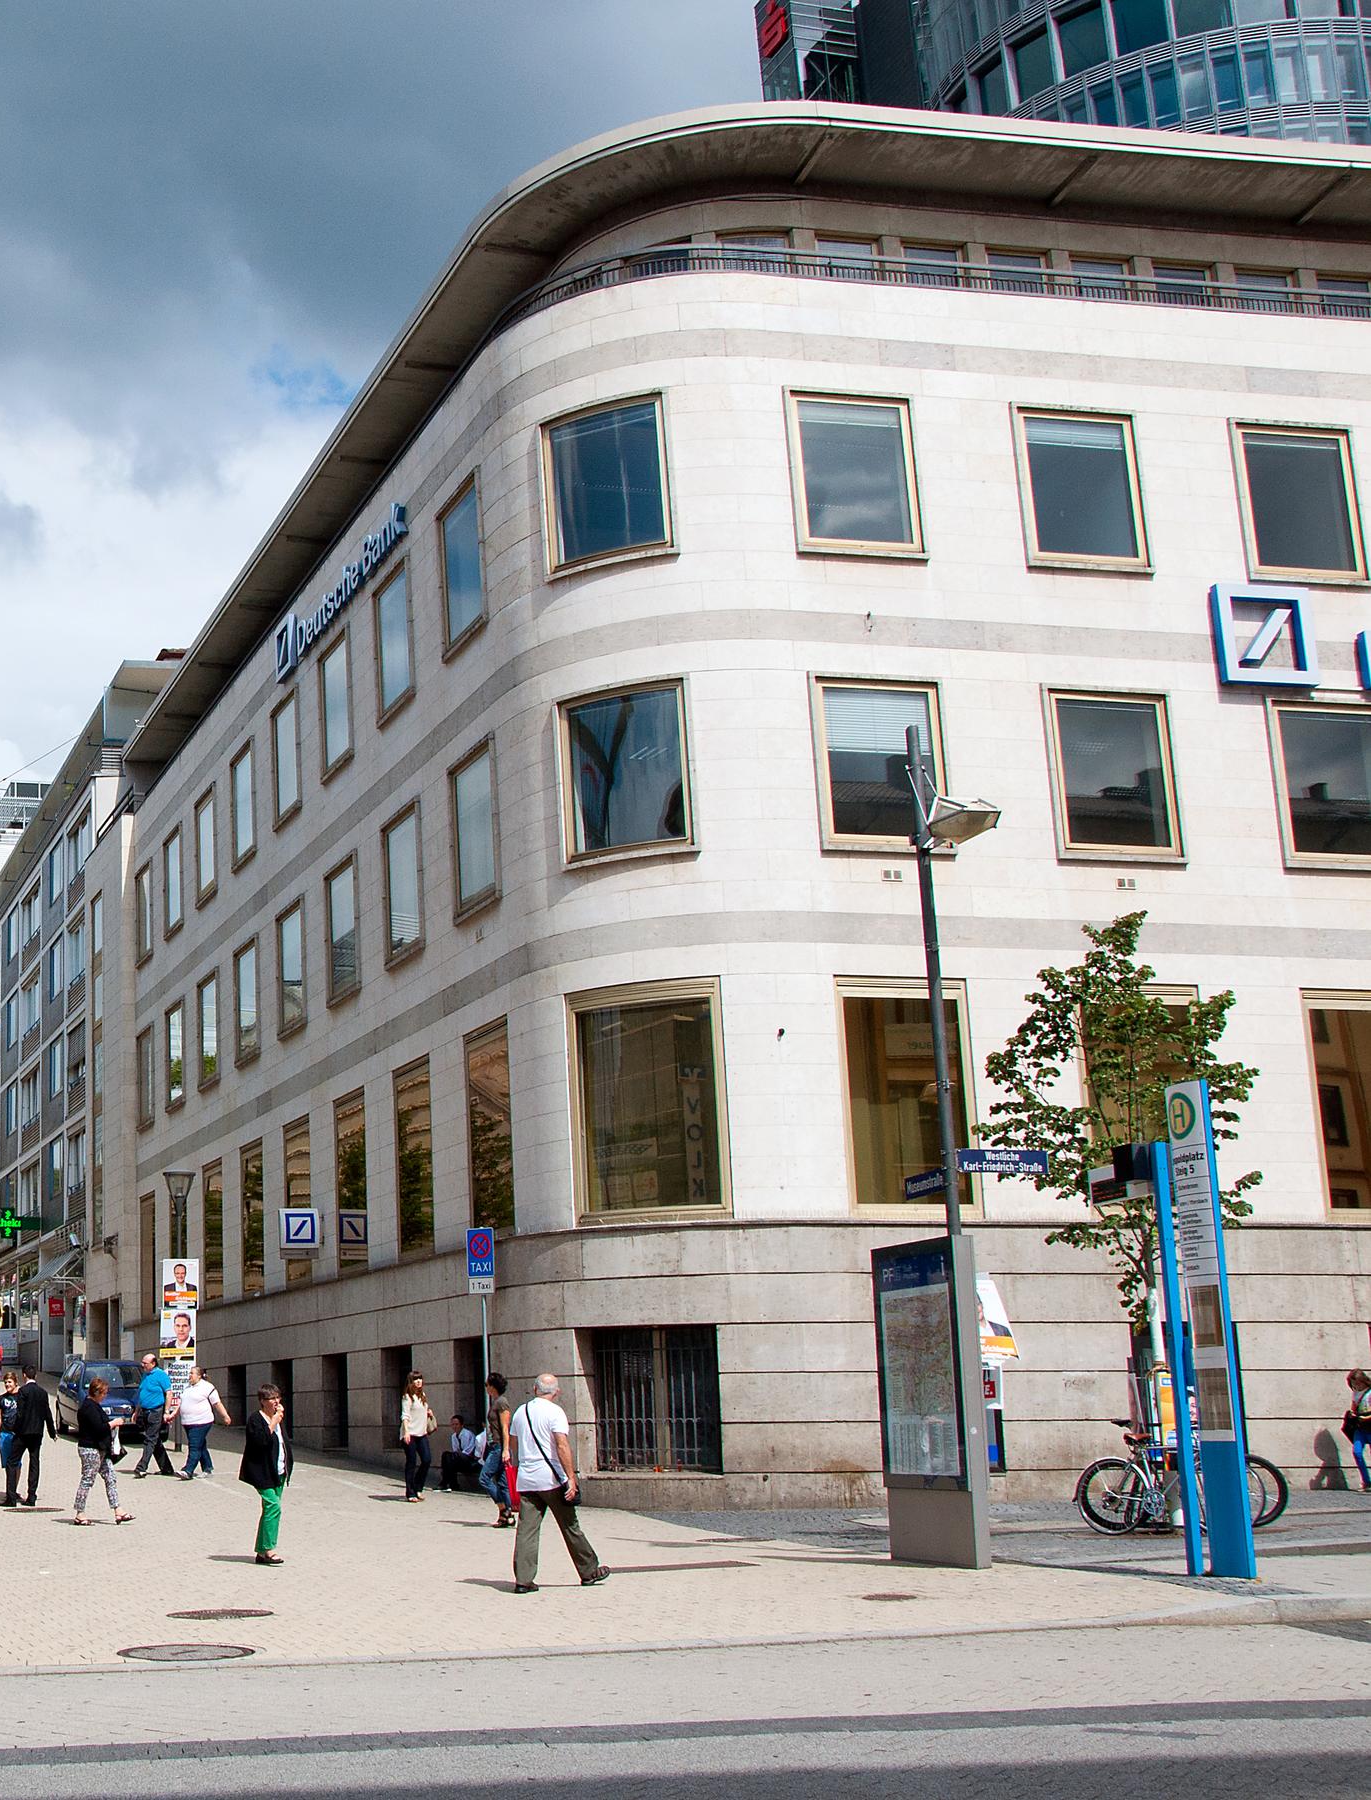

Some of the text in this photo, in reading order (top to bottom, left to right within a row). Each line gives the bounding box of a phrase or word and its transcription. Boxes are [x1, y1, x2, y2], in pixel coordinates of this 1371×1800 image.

[297, 503, 408, 656] Deutsche Bank
[985, 1151, 1020, 1161] Westliche
[963, 1161, 1043, 1172] Karl-Friedrich-Straße
[1189, 1164, 1196, 1174] 5
[470, 1262, 492, 1272] TAXI
[478, 1282, 491, 1290] Taxi
